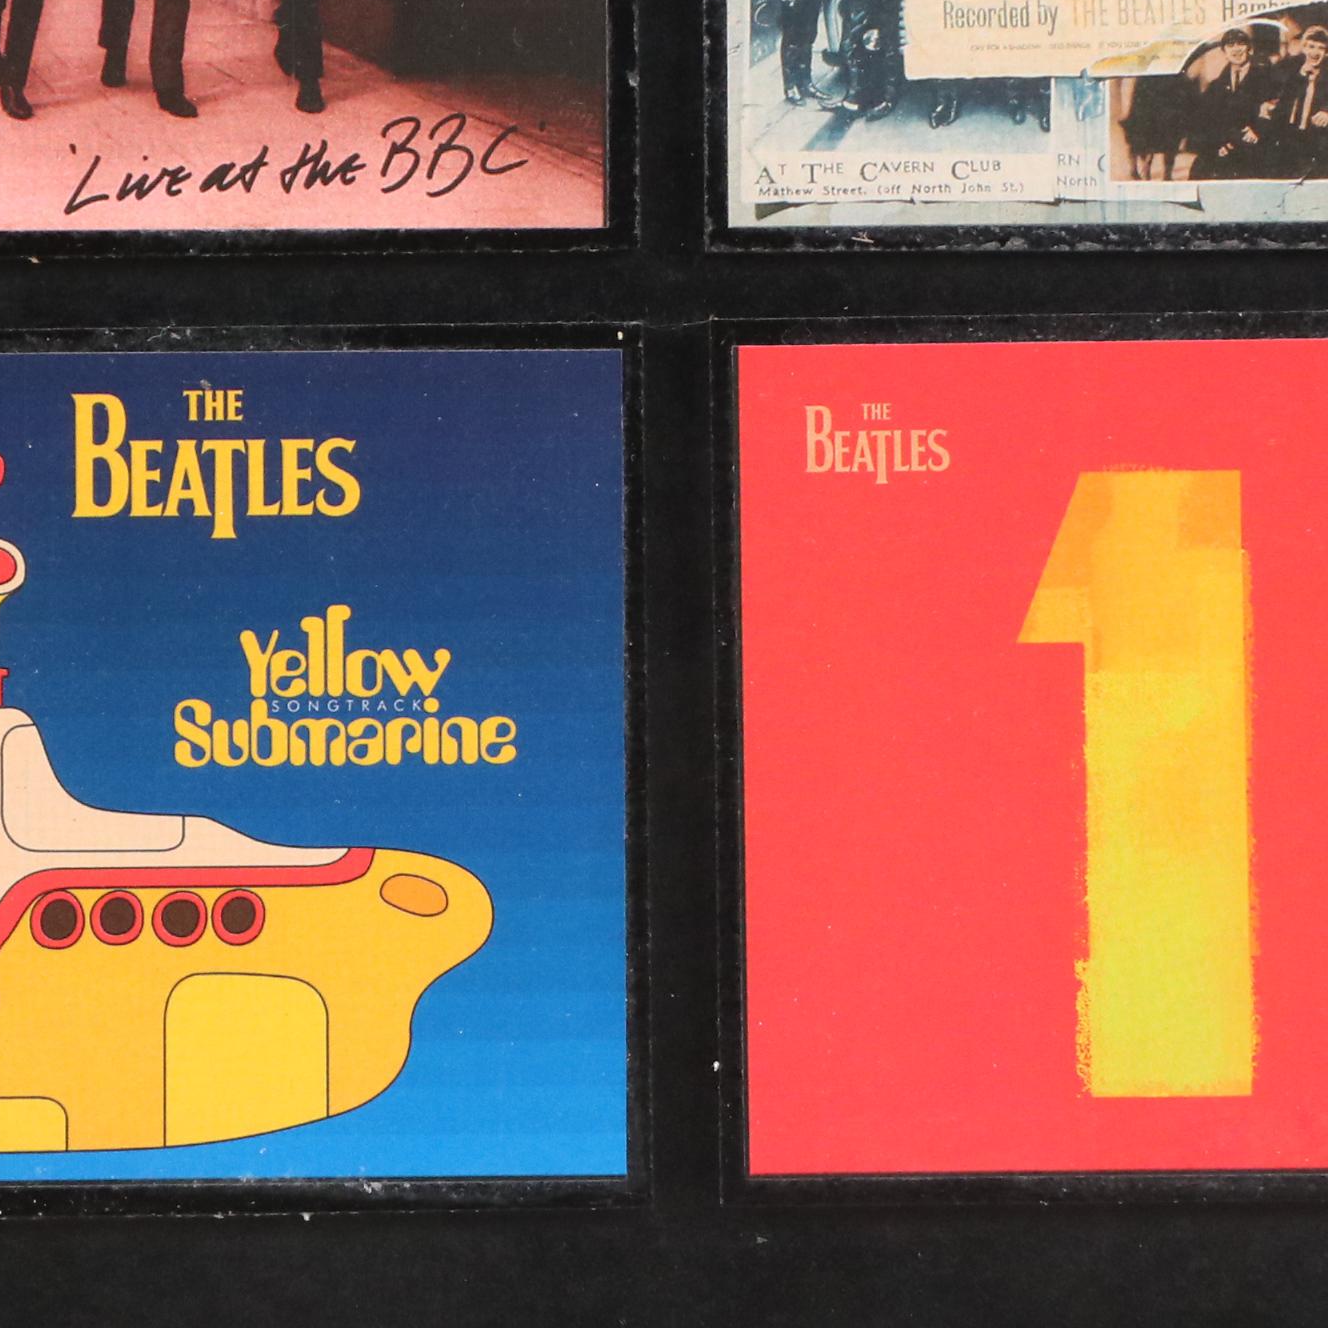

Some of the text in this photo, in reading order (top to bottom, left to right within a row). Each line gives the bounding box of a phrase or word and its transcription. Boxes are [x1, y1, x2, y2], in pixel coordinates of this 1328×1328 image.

[943, 0, 1030, 30] Recorded
[200, 145, 269, 193] at
[280, 139, 365, 193] the
[951, 159, 1002, 180] CLUB
[1056, 175, 1097, 188] North
[758, 184, 813, 197] Mathew
[911, 183, 952, 195] North
[960, 181, 992, 195] John
[183, 389, 244, 422] THE
[861, 403, 892, 421] THE
[804, 405, 951, 485] BEATLES
[71, 392, 362, 539] BEATLES
[239, 604, 452, 698] Yellow
[270, 698, 423, 713] SONGTRACK
[174, 696, 518, 768] Submarine
[1016, 468, 1262, 1098] 1
